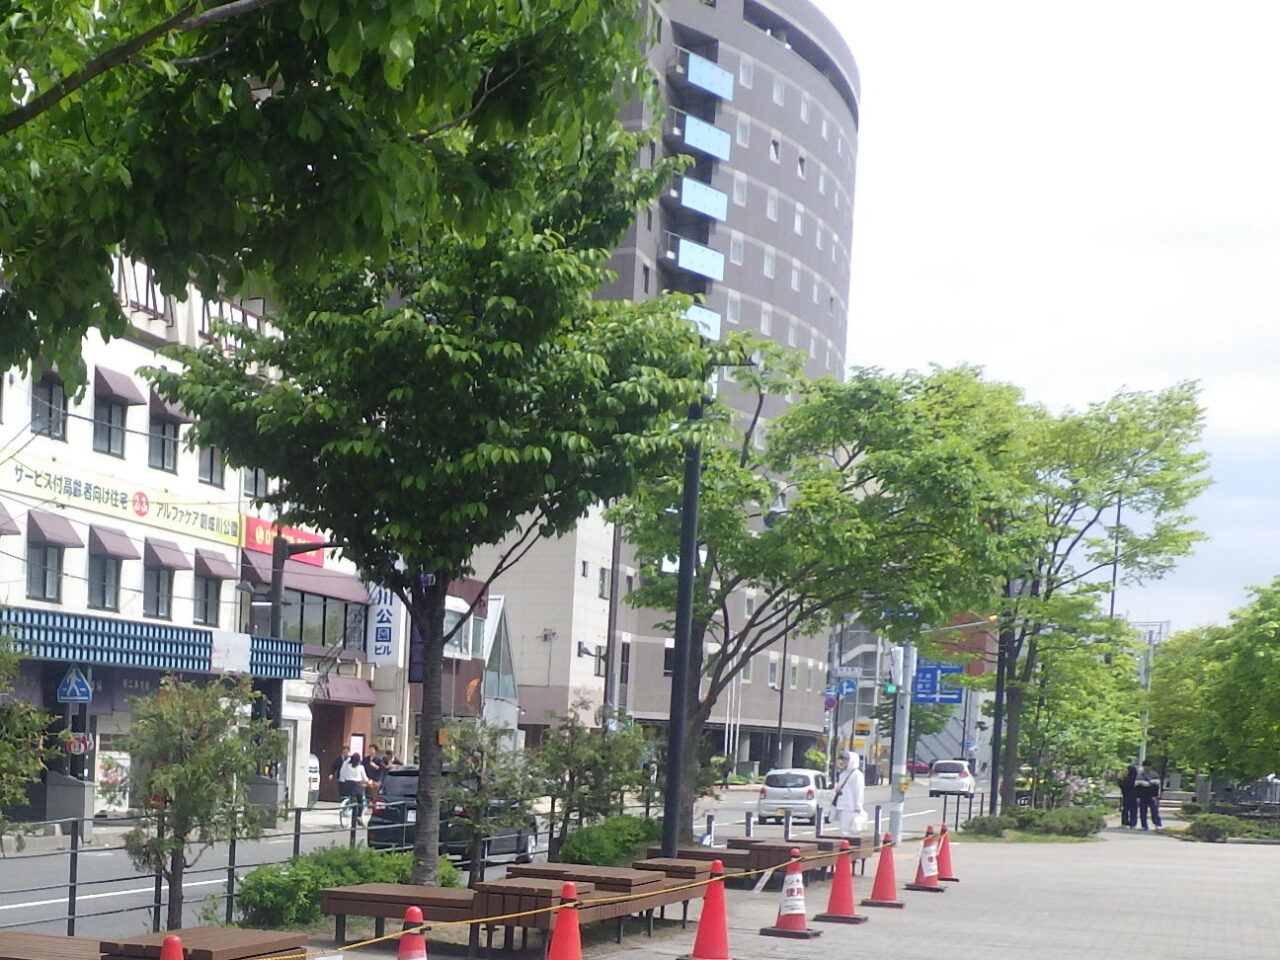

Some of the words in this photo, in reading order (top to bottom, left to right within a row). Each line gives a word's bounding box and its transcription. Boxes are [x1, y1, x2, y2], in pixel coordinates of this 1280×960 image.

[14, 463, 129, 510] サービス付高齢者向け住宅
[374, 589, 393, 656] 川公園ビル
